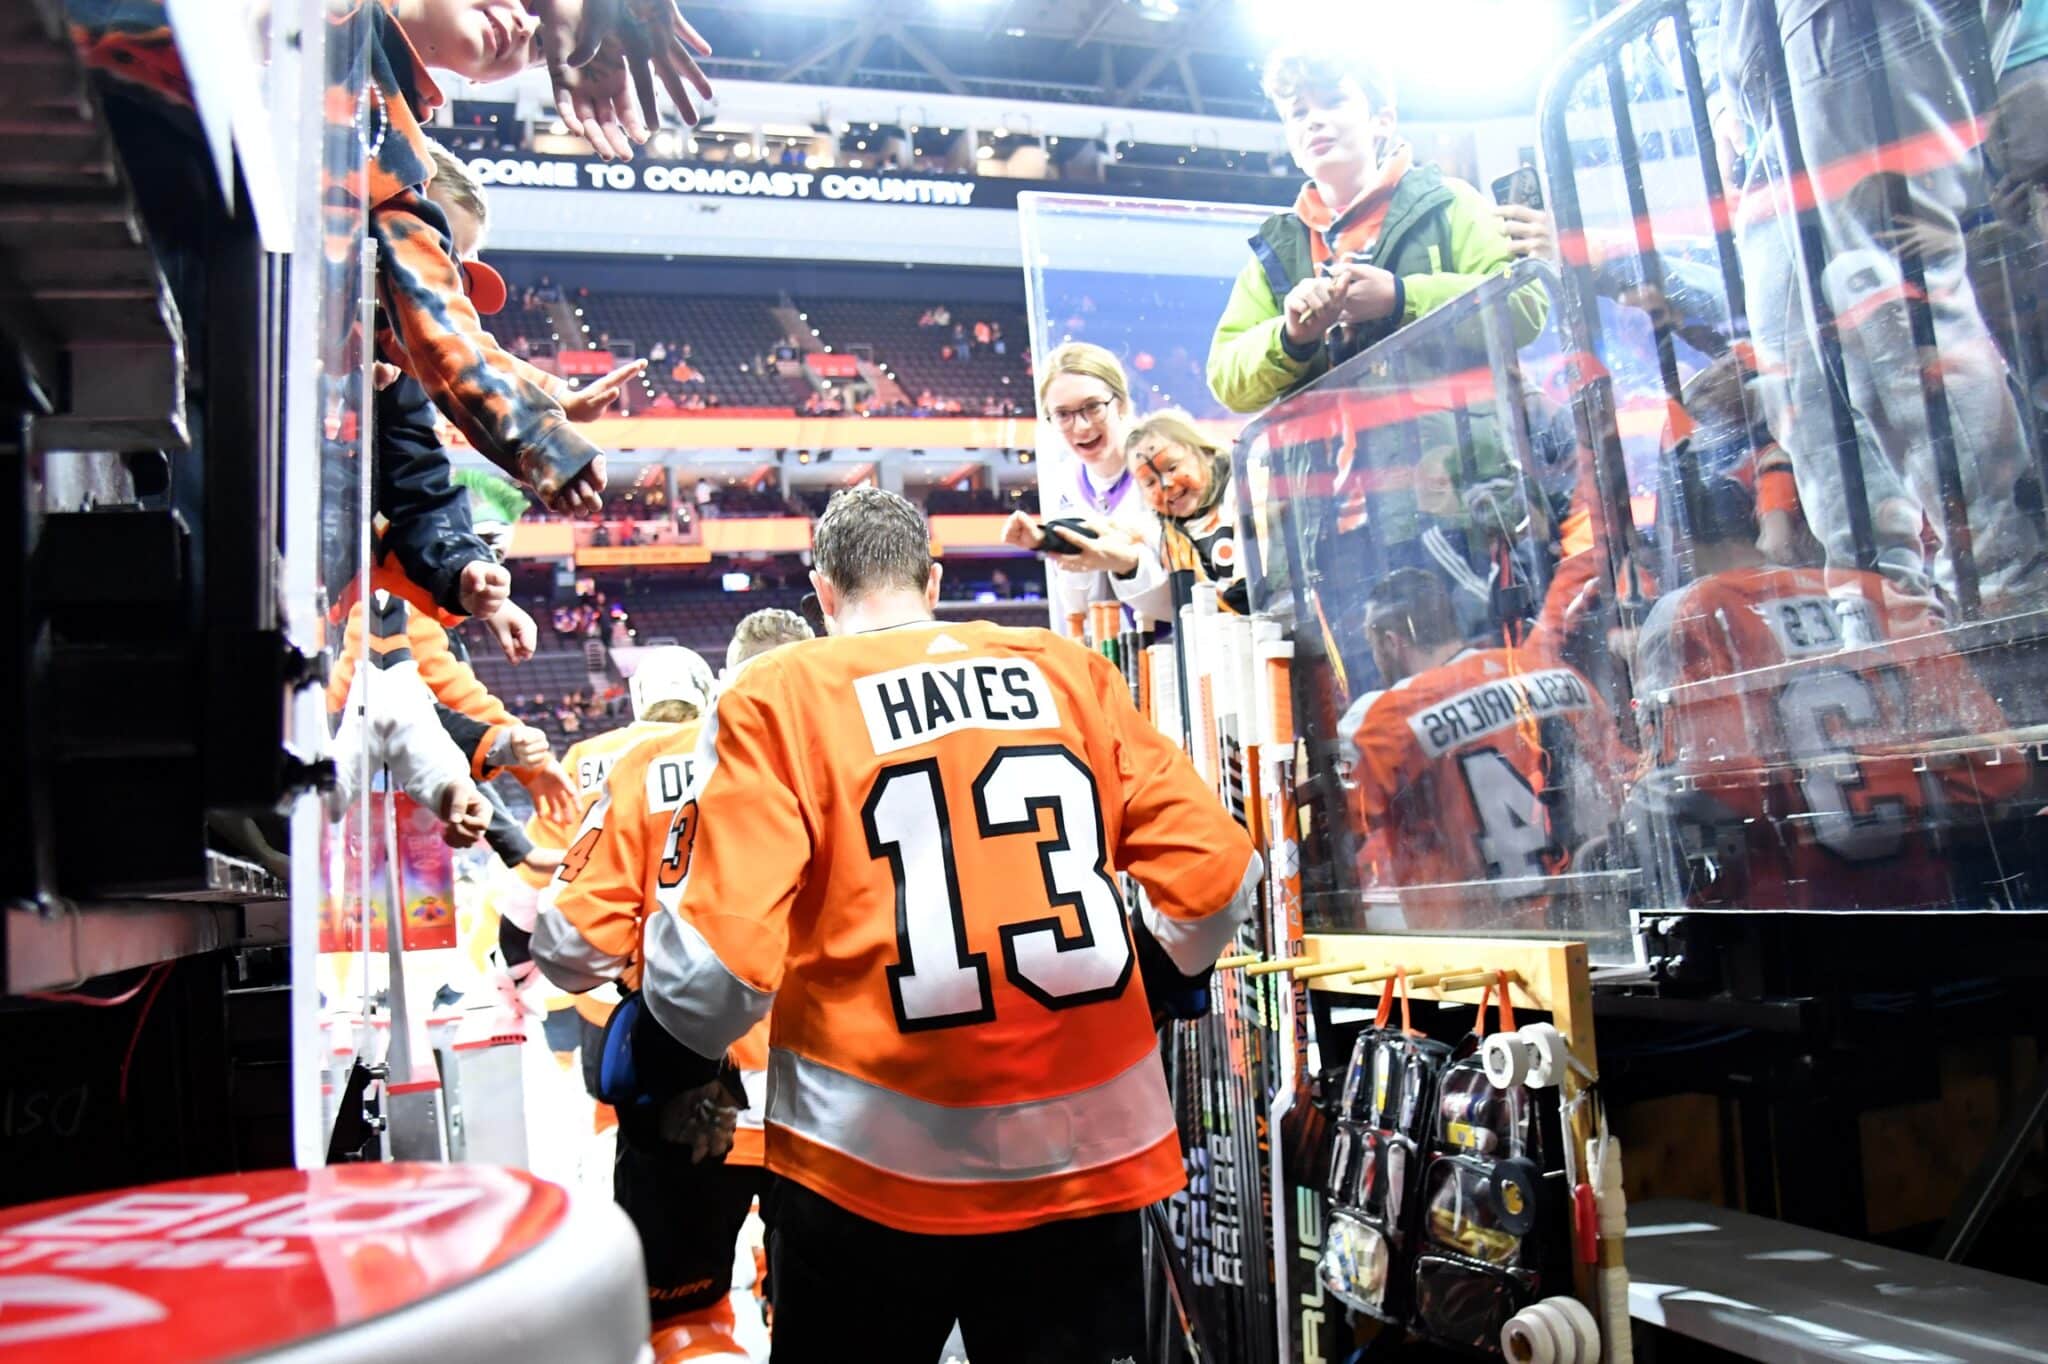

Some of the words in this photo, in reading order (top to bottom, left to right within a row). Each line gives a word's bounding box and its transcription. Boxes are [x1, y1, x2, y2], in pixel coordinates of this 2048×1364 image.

[468, 158, 578, 188] COME
[584, 163, 636, 190] TO
[643, 166, 814, 197] COMCAST
[821, 174, 976, 206] COUNTRY
[876, 665, 1039, 741] HAYES
[862, 743, 1135, 1033] 13
